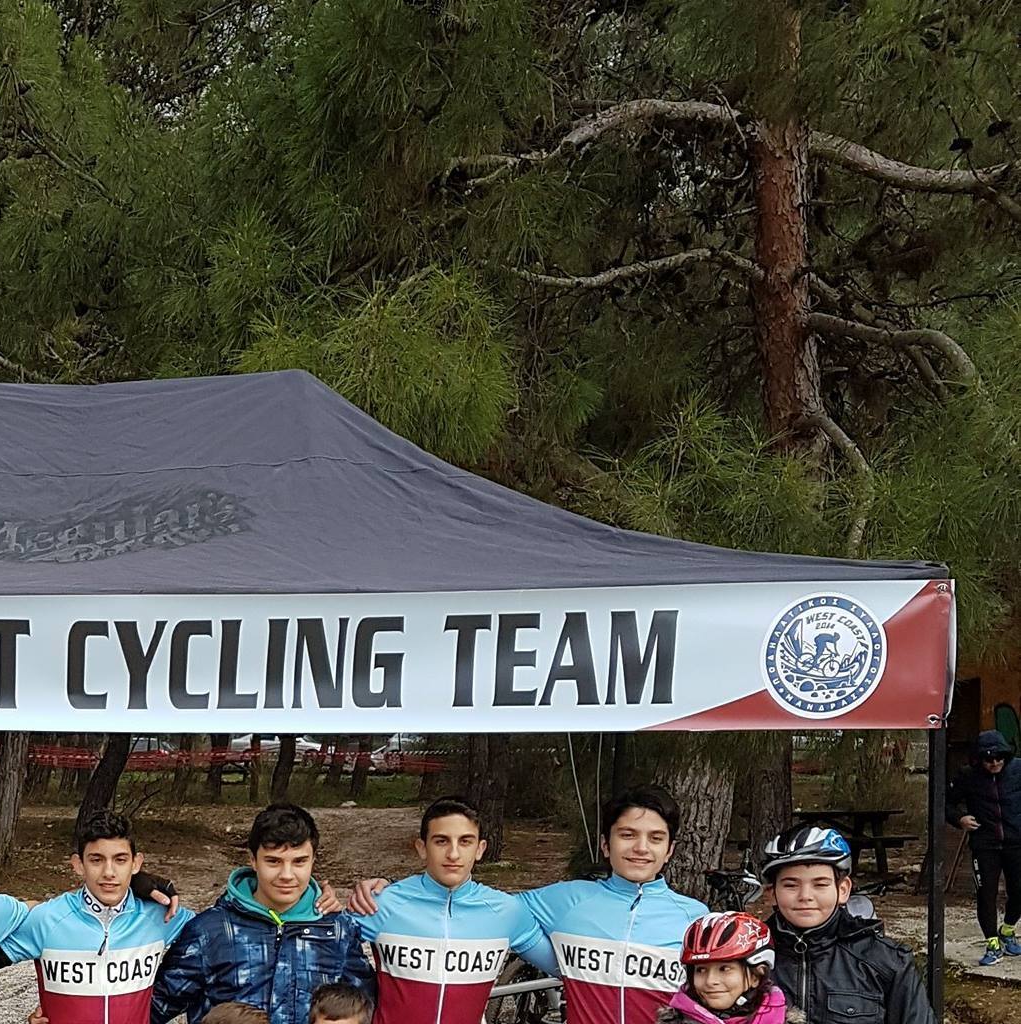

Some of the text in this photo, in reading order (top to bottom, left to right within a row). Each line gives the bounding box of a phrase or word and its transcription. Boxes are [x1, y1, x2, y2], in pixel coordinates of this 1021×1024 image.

[806, 612, 866, 642] WEST COAST
[67, 615, 406, 710] CYCLING
[443, 609, 679, 707] TEAM
[43, 952, 161, 984] WEST COAST
[378, 942, 505, 973] WEST COAST
[561, 943, 615, 974] WEST
